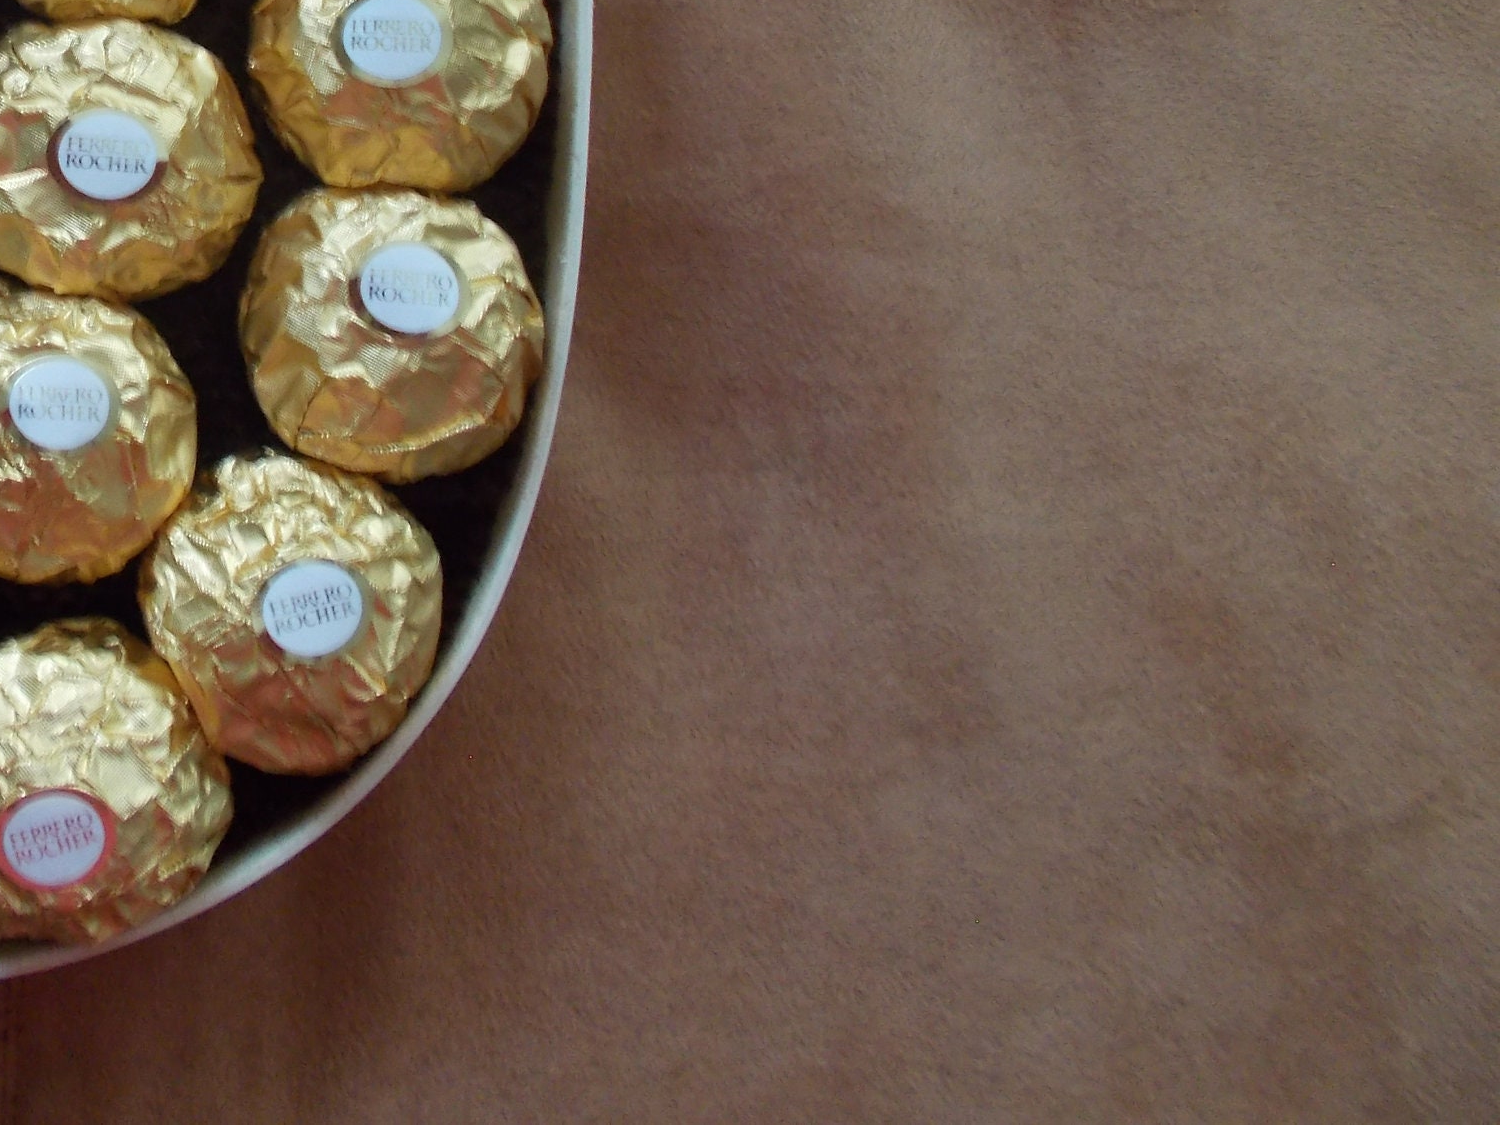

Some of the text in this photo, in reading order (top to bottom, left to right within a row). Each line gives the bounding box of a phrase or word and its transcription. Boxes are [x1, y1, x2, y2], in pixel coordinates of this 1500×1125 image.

[352, 19, 434, 37] FERRERO
[352, 36, 431, 52] ROCHER
[68, 137, 150, 155] FERRERO
[66, 154, 147, 173] ROCHER
[269, 584, 353, 613] FERRERO
[275, 601, 357, 636] ROCHER
[10, 809, 93, 845] FERRERO
[15, 829, 93, 865] ROCHER
